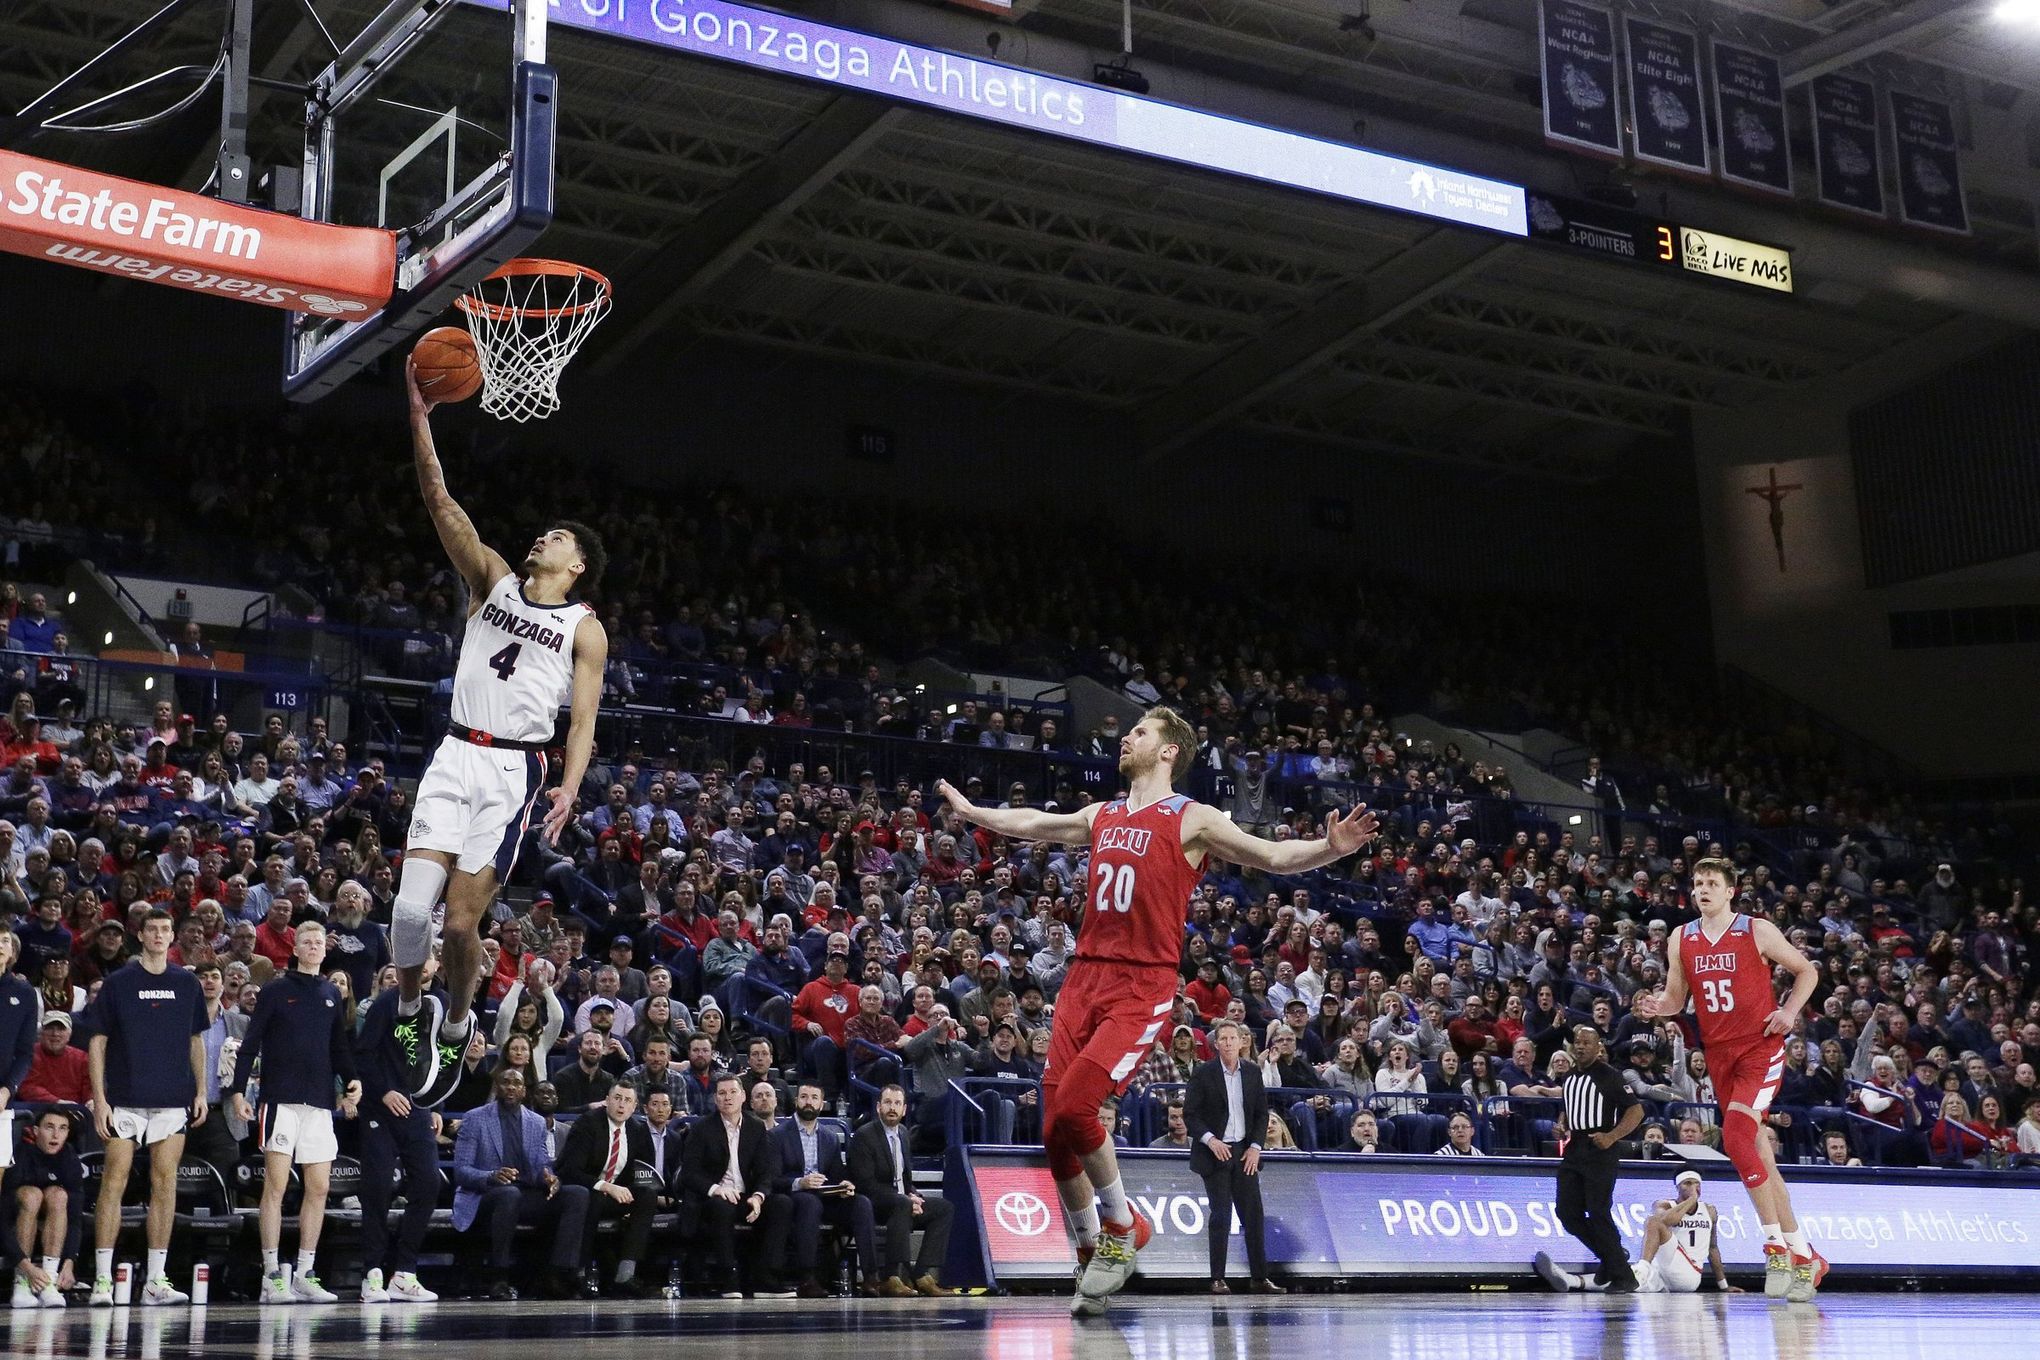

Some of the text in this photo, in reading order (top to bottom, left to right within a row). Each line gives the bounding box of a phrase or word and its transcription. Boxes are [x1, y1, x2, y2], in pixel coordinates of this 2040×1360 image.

[1562, 28, 1595, 45] NCAA
[650, 0, 869, 80] Gonzaga
[889, 47, 1086, 125] Athletics
[1648, 50, 1681, 67] NCAA
[1637, 63, 1662, 78] Elite
[1569, 228, 1636, 257] 3-POINTERS
[1657, 226, 1673, 261] 3
[1686, 254, 1708, 265] TACO
[1687, 262, 1709, 272] BELL
[1750, 259, 1787, 283] MÁS
[482, 603, 565, 653] GONZAGA
[489, 642, 523, 682] 4
[275, 692, 297, 706] 113
[1084, 770, 1102, 782] 114
[1097, 827, 1152, 857] LMU
[1697, 831, 1712, 841] 115
[1096, 862, 1136, 913] 20
[1695, 952, 1736, 974] LMU
[138, 990, 176, 1000] GONZAGA
[1702, 978, 1736, 1013] 35
[1377, 1199, 1518, 1237] PROUD
[1717, 1205, 1747, 1239] of
[1903, 1209, 2029, 1243] Athletics
[1688, 1230, 1696, 1247] 1
